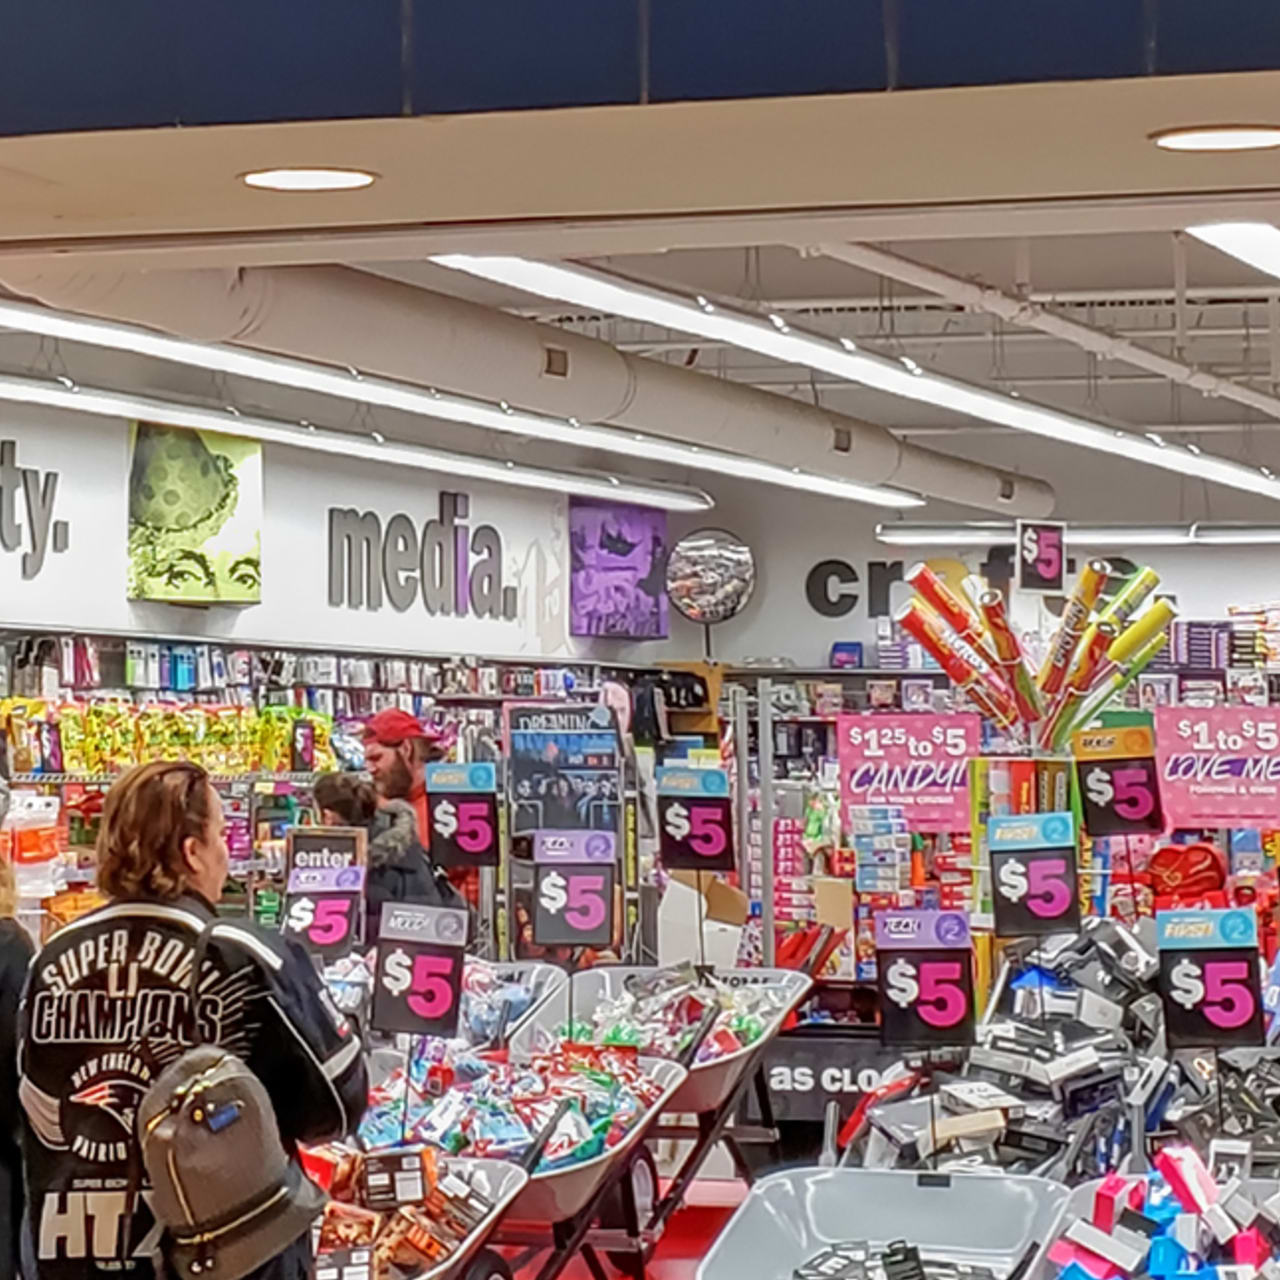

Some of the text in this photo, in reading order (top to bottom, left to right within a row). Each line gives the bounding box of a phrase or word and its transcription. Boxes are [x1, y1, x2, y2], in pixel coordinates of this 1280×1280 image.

[328, 491, 518, 620] media.
[1022, 527, 1062, 580] $5
[908, 736, 933, 757] to
[932, 726, 967, 757] $5
[1216, 730, 1243, 751] to
[1242, 720, 1280, 750] $5
[850, 756, 970, 794] CANDY!
[1164, 751, 1238, 782] LOVE
[1085, 767, 1155, 820] $5
[432, 799, 494, 853] $5
[664, 802, 727, 856] $5
[293, 847, 354, 869] enter
[538, 870, 607, 932] $5
[998, 857, 1074, 919] $5
[287, 897, 352, 945] $5
[42, 928, 128, 999] SUPER
[107, 961, 140, 999] LI
[381, 948, 455, 1019] $5
[32, 988, 222, 1046] CHAMPIONS
[886, 957, 968, 1028] $5
[1169, 957, 1256, 1029] $5
[72, 1134, 130, 1162] PATRIO
